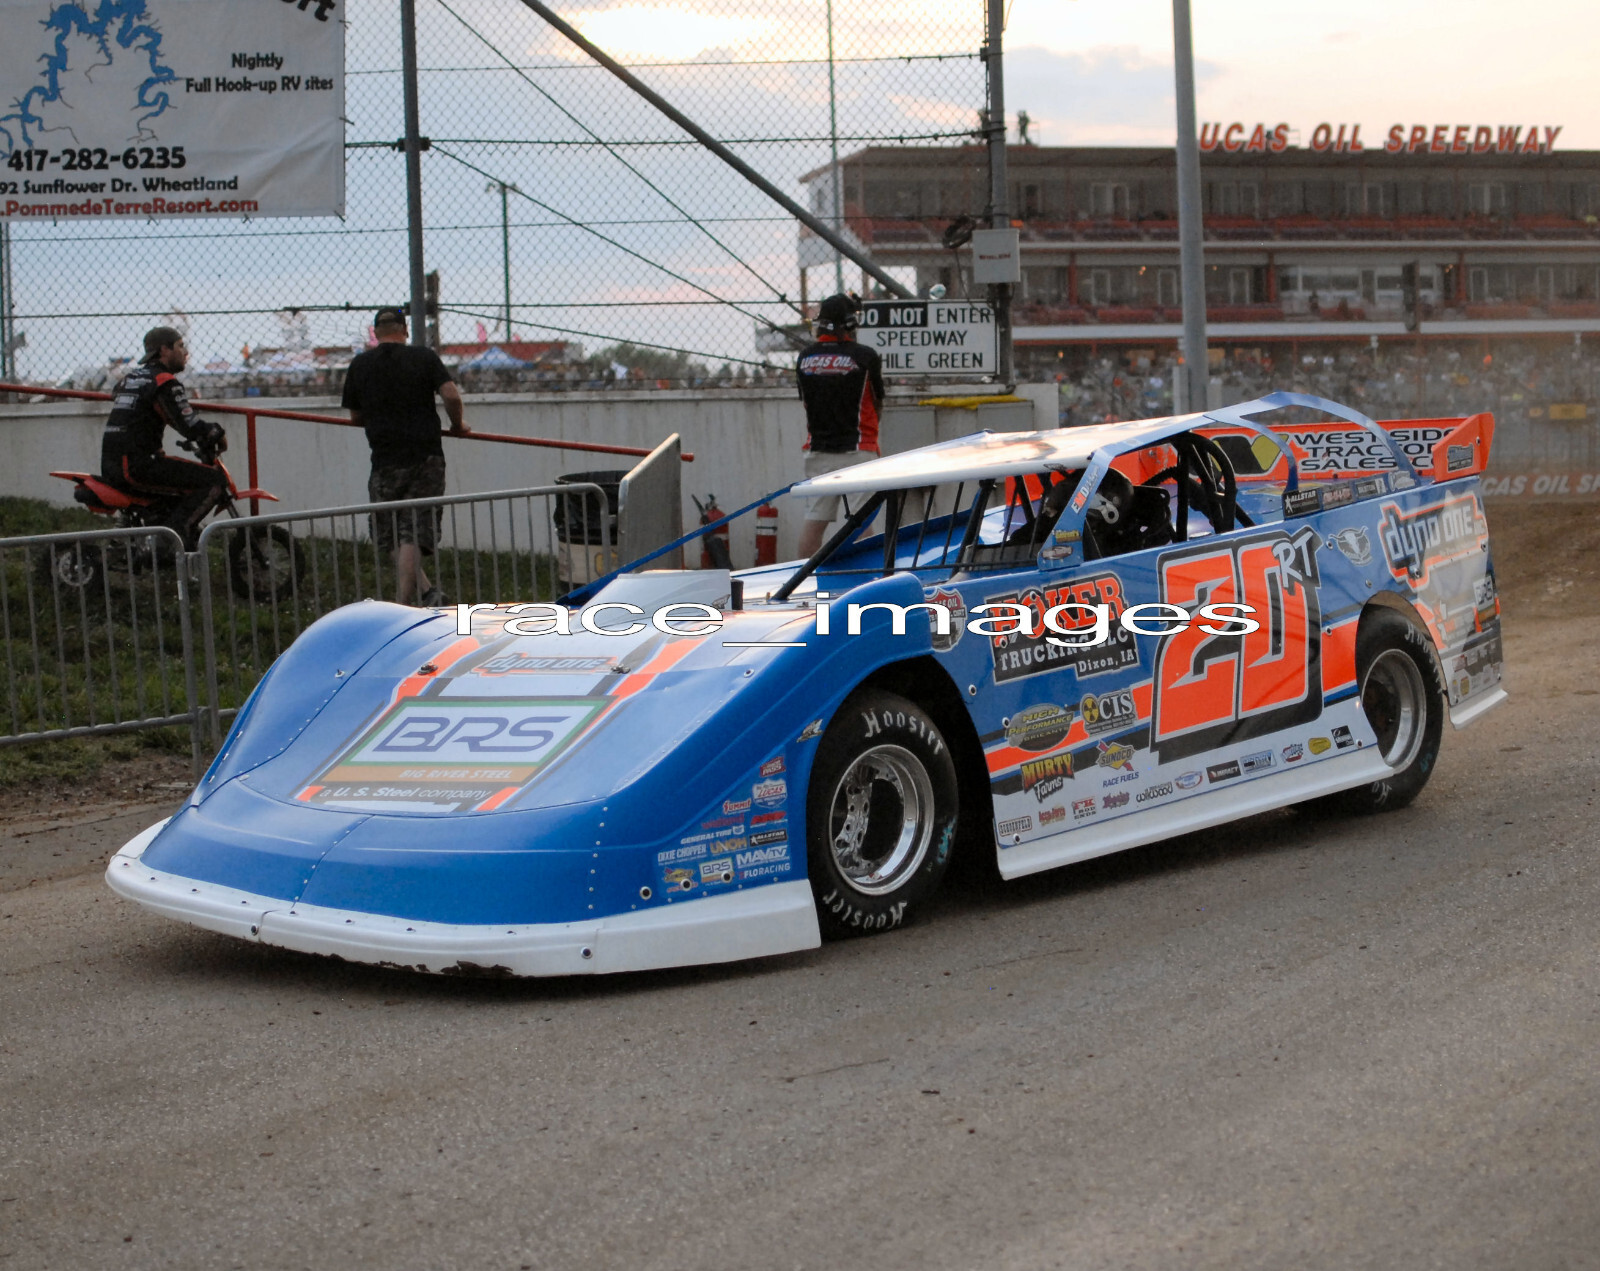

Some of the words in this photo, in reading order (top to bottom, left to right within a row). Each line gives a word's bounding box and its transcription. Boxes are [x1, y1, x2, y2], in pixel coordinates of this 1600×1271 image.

[231, 52, 283, 70] Nightly
[186, 78, 211, 93] Full
[215, 77, 277, 94] Hook-up
[282, 77, 301, 91] RV
[305, 76, 334, 91] sites
[1199, 121, 1290, 152] UCAS
[1310, 121, 1363, 152] OIL
[1384, 123, 1564, 154] SPEEDWAY
[7, 146, 186, 171] 417-282-6235
[23, 178, 106, 194] Sunflower
[111, 178, 138, 192] Dr.
[143, 176, 238, 193] Wheatland
[889, 307, 924, 325] NOT
[936, 307, 991, 324] ENTER
[876, 330, 968, 347] SPEEDWAY
[800, 356, 832, 369] LUCAS
[832, 355, 852, 367] OIL
[880, 352, 915, 369] HILE
[928, 352, 983, 369] GREEN
[1294, 431, 1377, 445] WEST
[1306, 443, 1437, 458] TRACO
[1301, 456, 1398, 471] SALES
[1412, 455, 1434, 468] C
[1480, 475, 1528, 496] CAS
[1532, 474, 1570, 495] OIL
[1290, 490, 1316, 502] ALLSTAR
[1153, 541, 1311, 743] 20
[1273, 531, 1314, 588] RT
[1000, 633, 1090, 671] TRUCKING
[1079, 657, 1119, 673] Dixon,
[1120, 649, 1135, 663] IA
[1022, 706, 1060, 723] HIGH
[1099, 693, 1133, 720] CIS
[861, 708, 944, 756] Hoosier
[1009, 713, 1073, 735] PERFORMANCE
[371, 716, 572, 752] BRS
[1100, 747, 1134, 767] SUNOCO
[399, 769, 424, 779] BIG
[426, 769, 470, 779] RIVER
[470, 769, 512, 779] STEEL
[1021, 752, 1074, 792] MURTY
[1102, 777, 1119, 788] RACE
[1120, 771, 1140, 783] FUELS
[319, 789, 330, 797] a
[332, 787, 350, 797] U.
[353, 787, 368, 797] S.
[373, 787, 419, 798] Steel
[418, 789, 492, 801] company
[1034, 776, 1064, 801] Farms
[680, 832, 714, 845] GENERAL
[657, 849, 676, 862] DIXIE
[676, 844, 707, 858] CHOPPER
[736, 845, 788, 865] MAVTV
[702, 861, 730, 875] BRS
[744, 862, 791, 879] FLORACING
